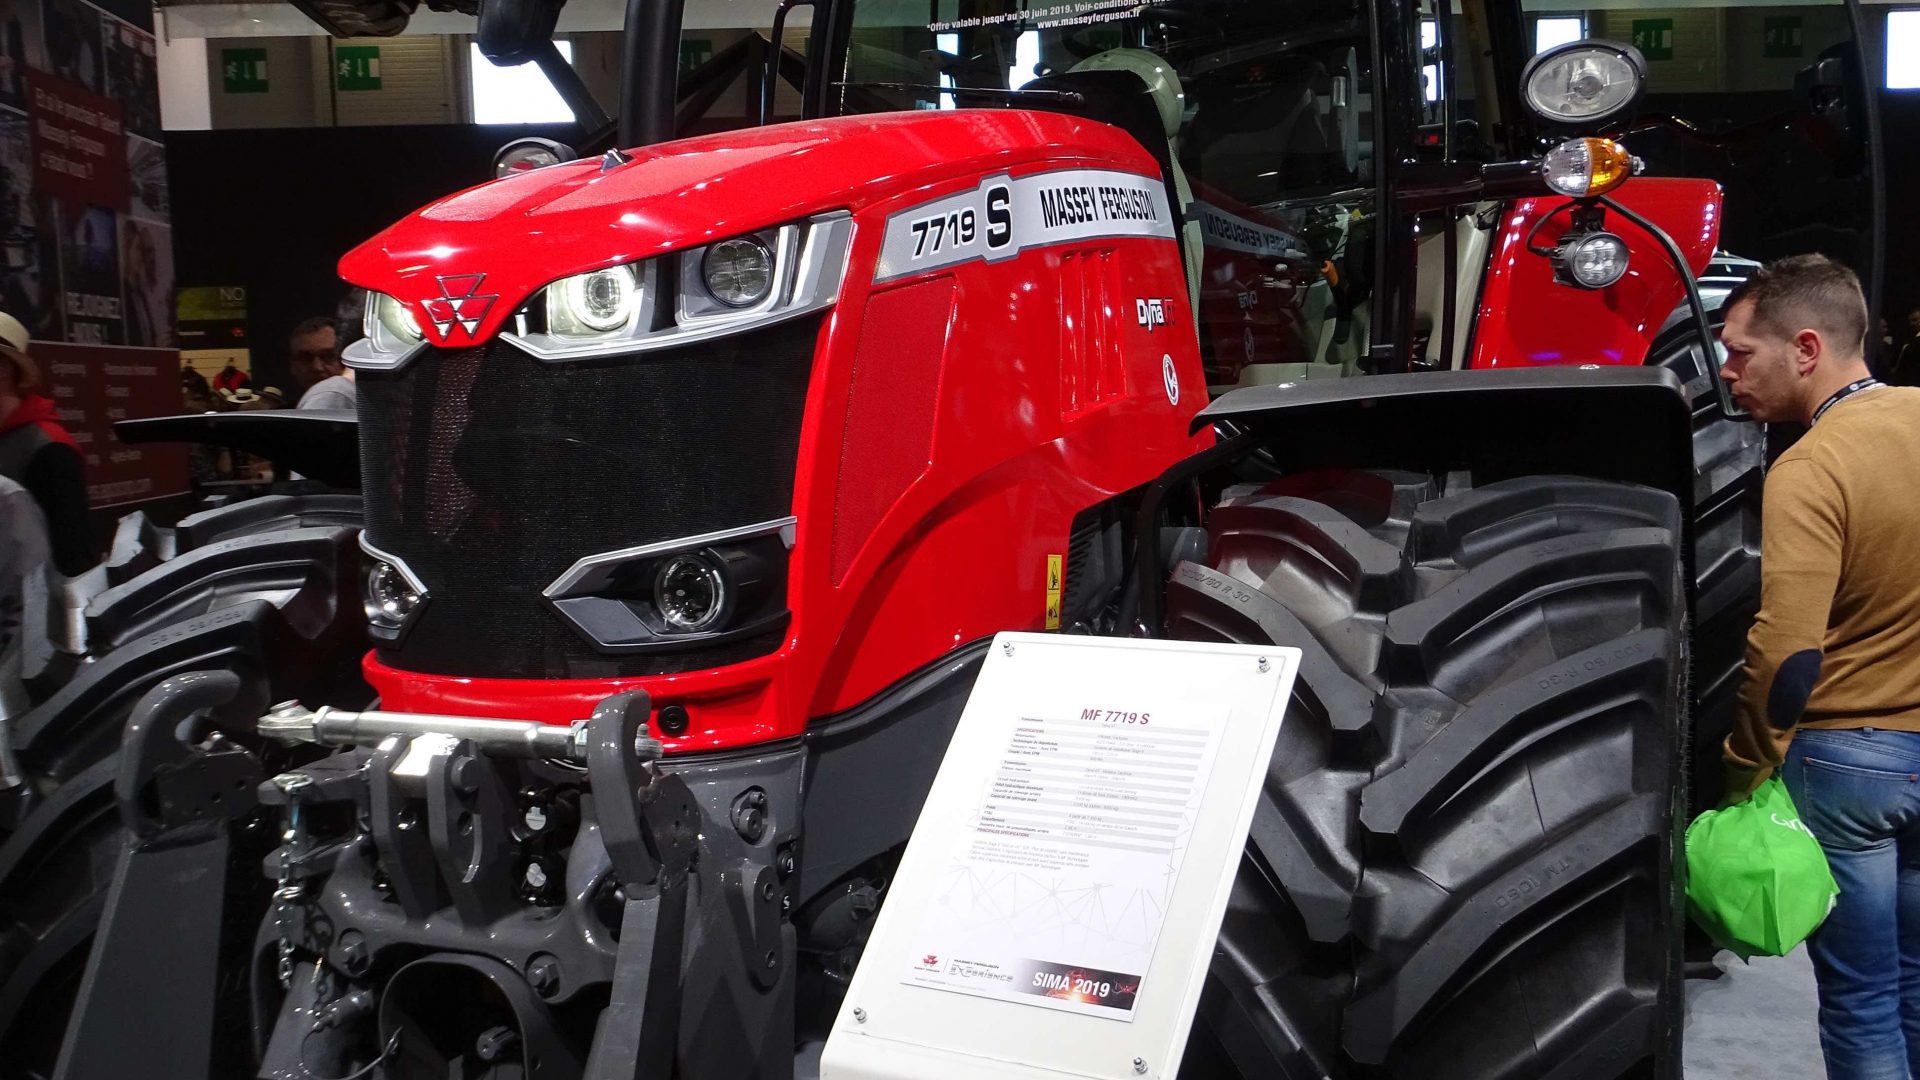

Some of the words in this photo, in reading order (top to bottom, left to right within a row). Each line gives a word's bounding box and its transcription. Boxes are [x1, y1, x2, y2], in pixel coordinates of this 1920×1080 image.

[952, 17, 980, 29] valable
[981, 12, 1018, 26] jusqu'au
[1019, 10, 1030, 20] 30
[1031, 7, 1048, 19] juin
[1037, 10, 1141, 29] www.masseyferguson.fr
[1040, 186, 1099, 228] MASSEY
[1098, 186, 1157, 222] FERGUSON
[911, 207, 975, 260] 7719
[985, 183, 1012, 250] S
[1080, 708, 1102, 722] MF
[1105, 710, 1138, 725] 7719
[1140, 712, 1151, 726] S
[1032, 972, 1069, 992] SIMA
[1074, 978, 1111, 998] 2019
